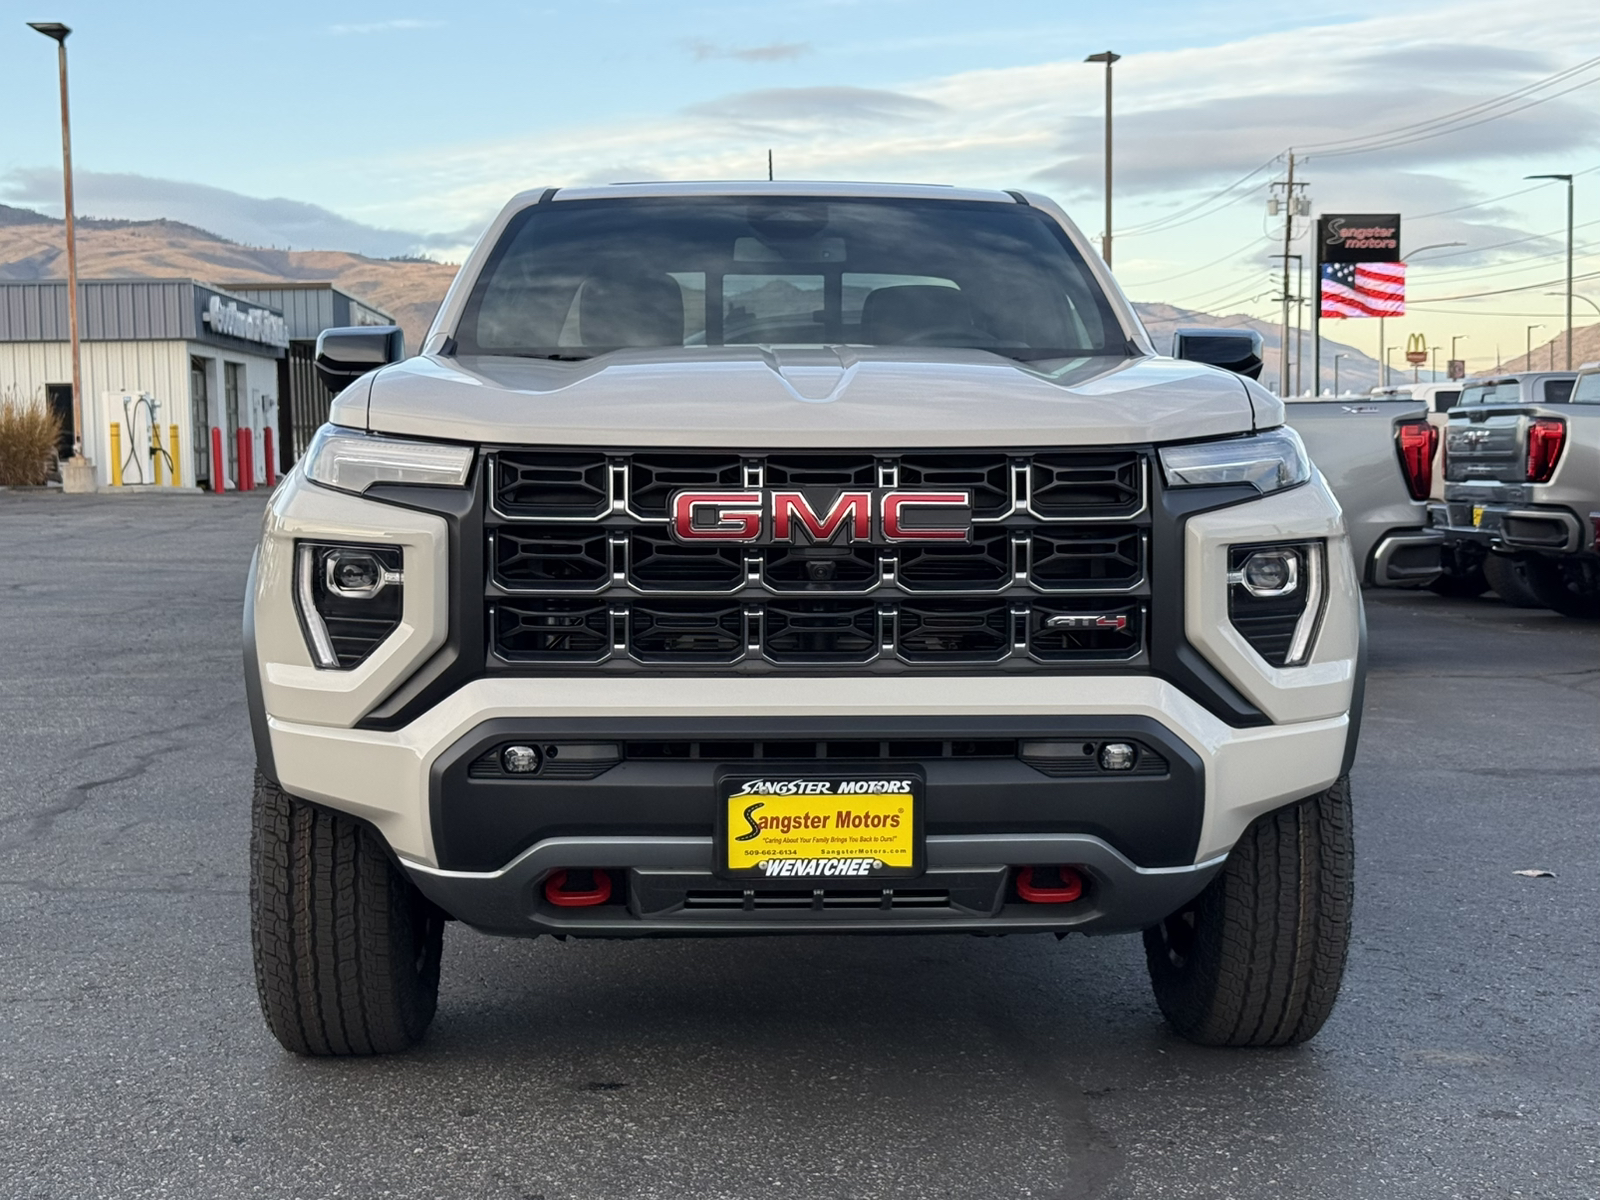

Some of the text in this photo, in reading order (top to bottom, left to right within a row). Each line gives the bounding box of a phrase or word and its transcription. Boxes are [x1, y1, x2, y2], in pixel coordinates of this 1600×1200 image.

[1326, 218, 1396, 245] Sangster
[1344, 238, 1397, 249] motors
[673, 491, 970, 543] GMC
[1047, 615, 1127, 631] AT4
[729, 778, 912, 798] SANGSTER MOTORS
[735, 802, 831, 841] Sangster
[812, 836, 830, 844] Family
[830, 836, 848, 844] Brings
[765, 858, 875, 876] WENATCHEE
